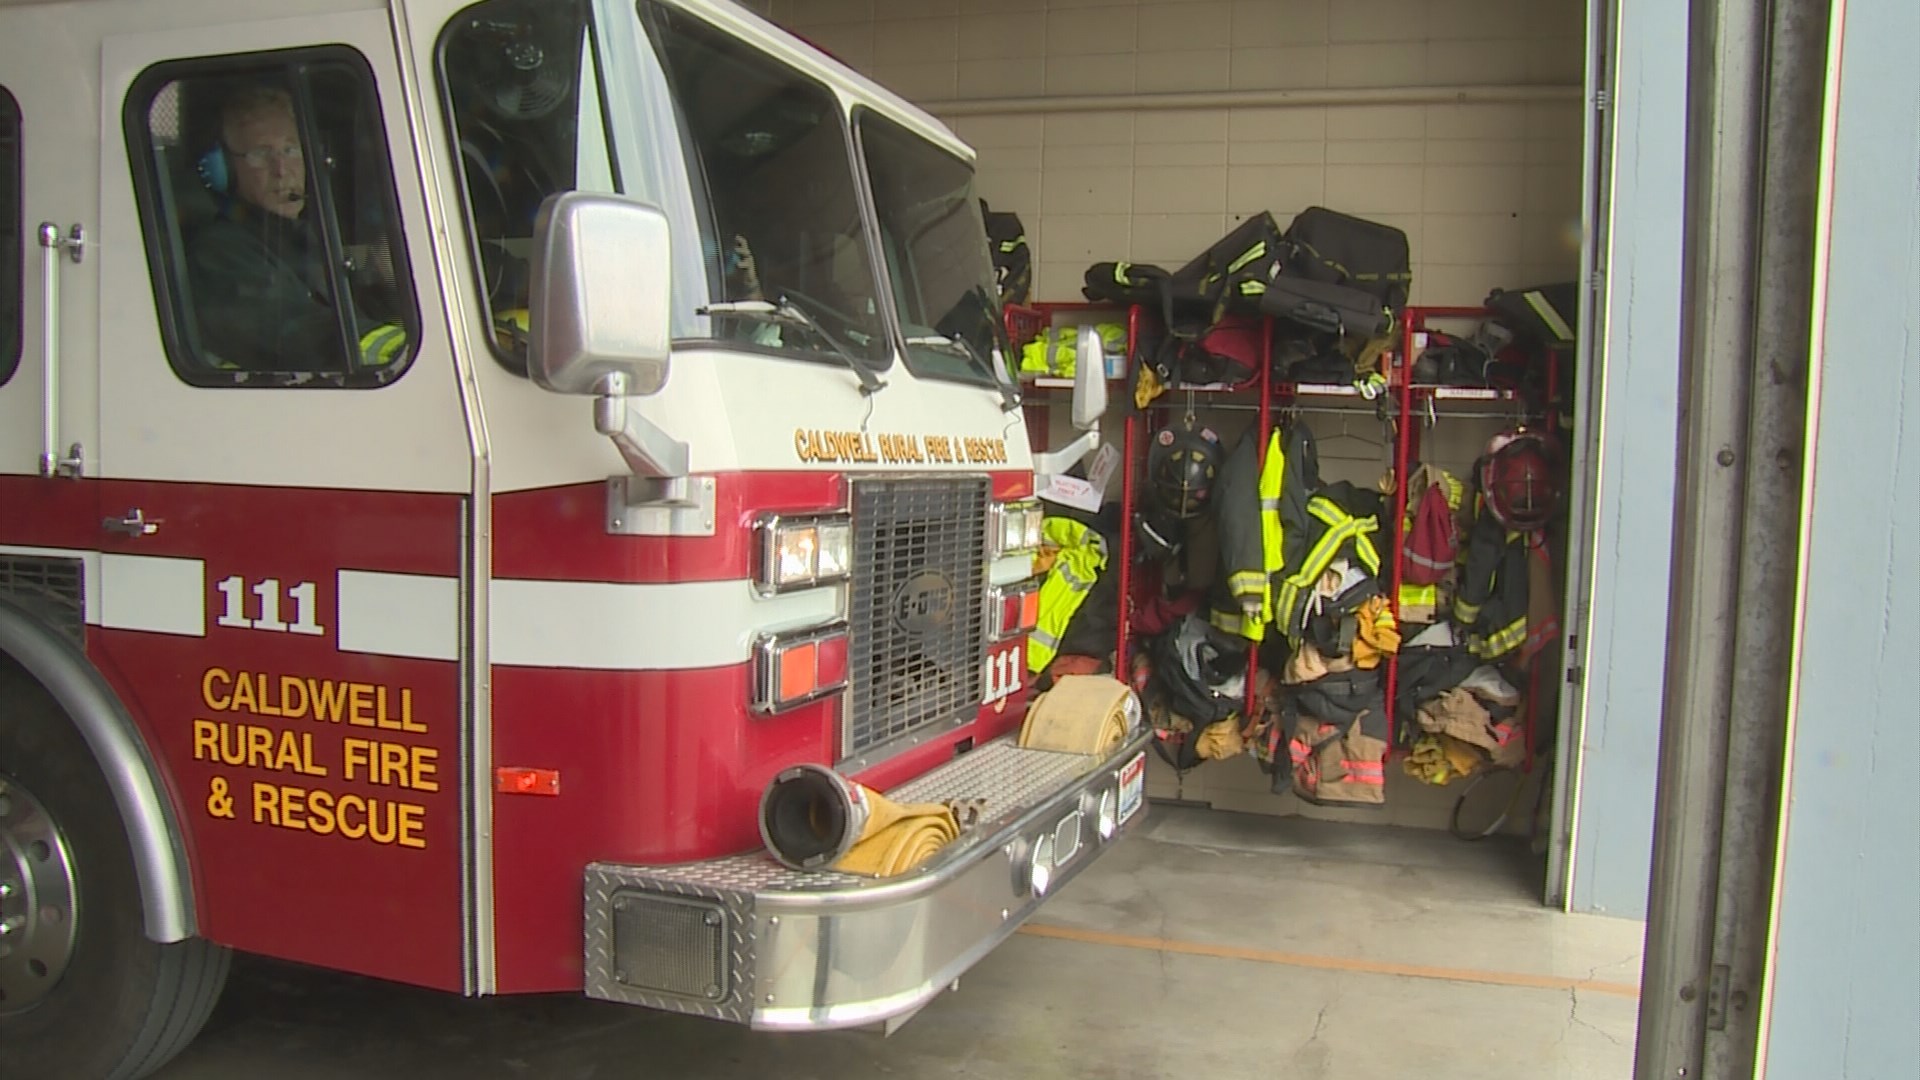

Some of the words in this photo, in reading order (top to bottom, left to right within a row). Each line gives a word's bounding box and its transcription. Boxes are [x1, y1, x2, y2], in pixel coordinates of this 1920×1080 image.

[795, 428, 877, 463] CALDWELL
[878, 433, 924, 463] RURAL
[924, 435, 952, 463] FIRE
[964, 436, 1007, 464] RESCUE
[217, 575, 324, 636] 111
[202, 667, 428, 733] CALDWELL
[981, 646, 1022, 705] 111
[193, 719, 328, 776] RURAL
[343, 737, 439, 791] FIRE
[207, 776, 235, 819] &
[252, 782, 426, 848] RESCUE
